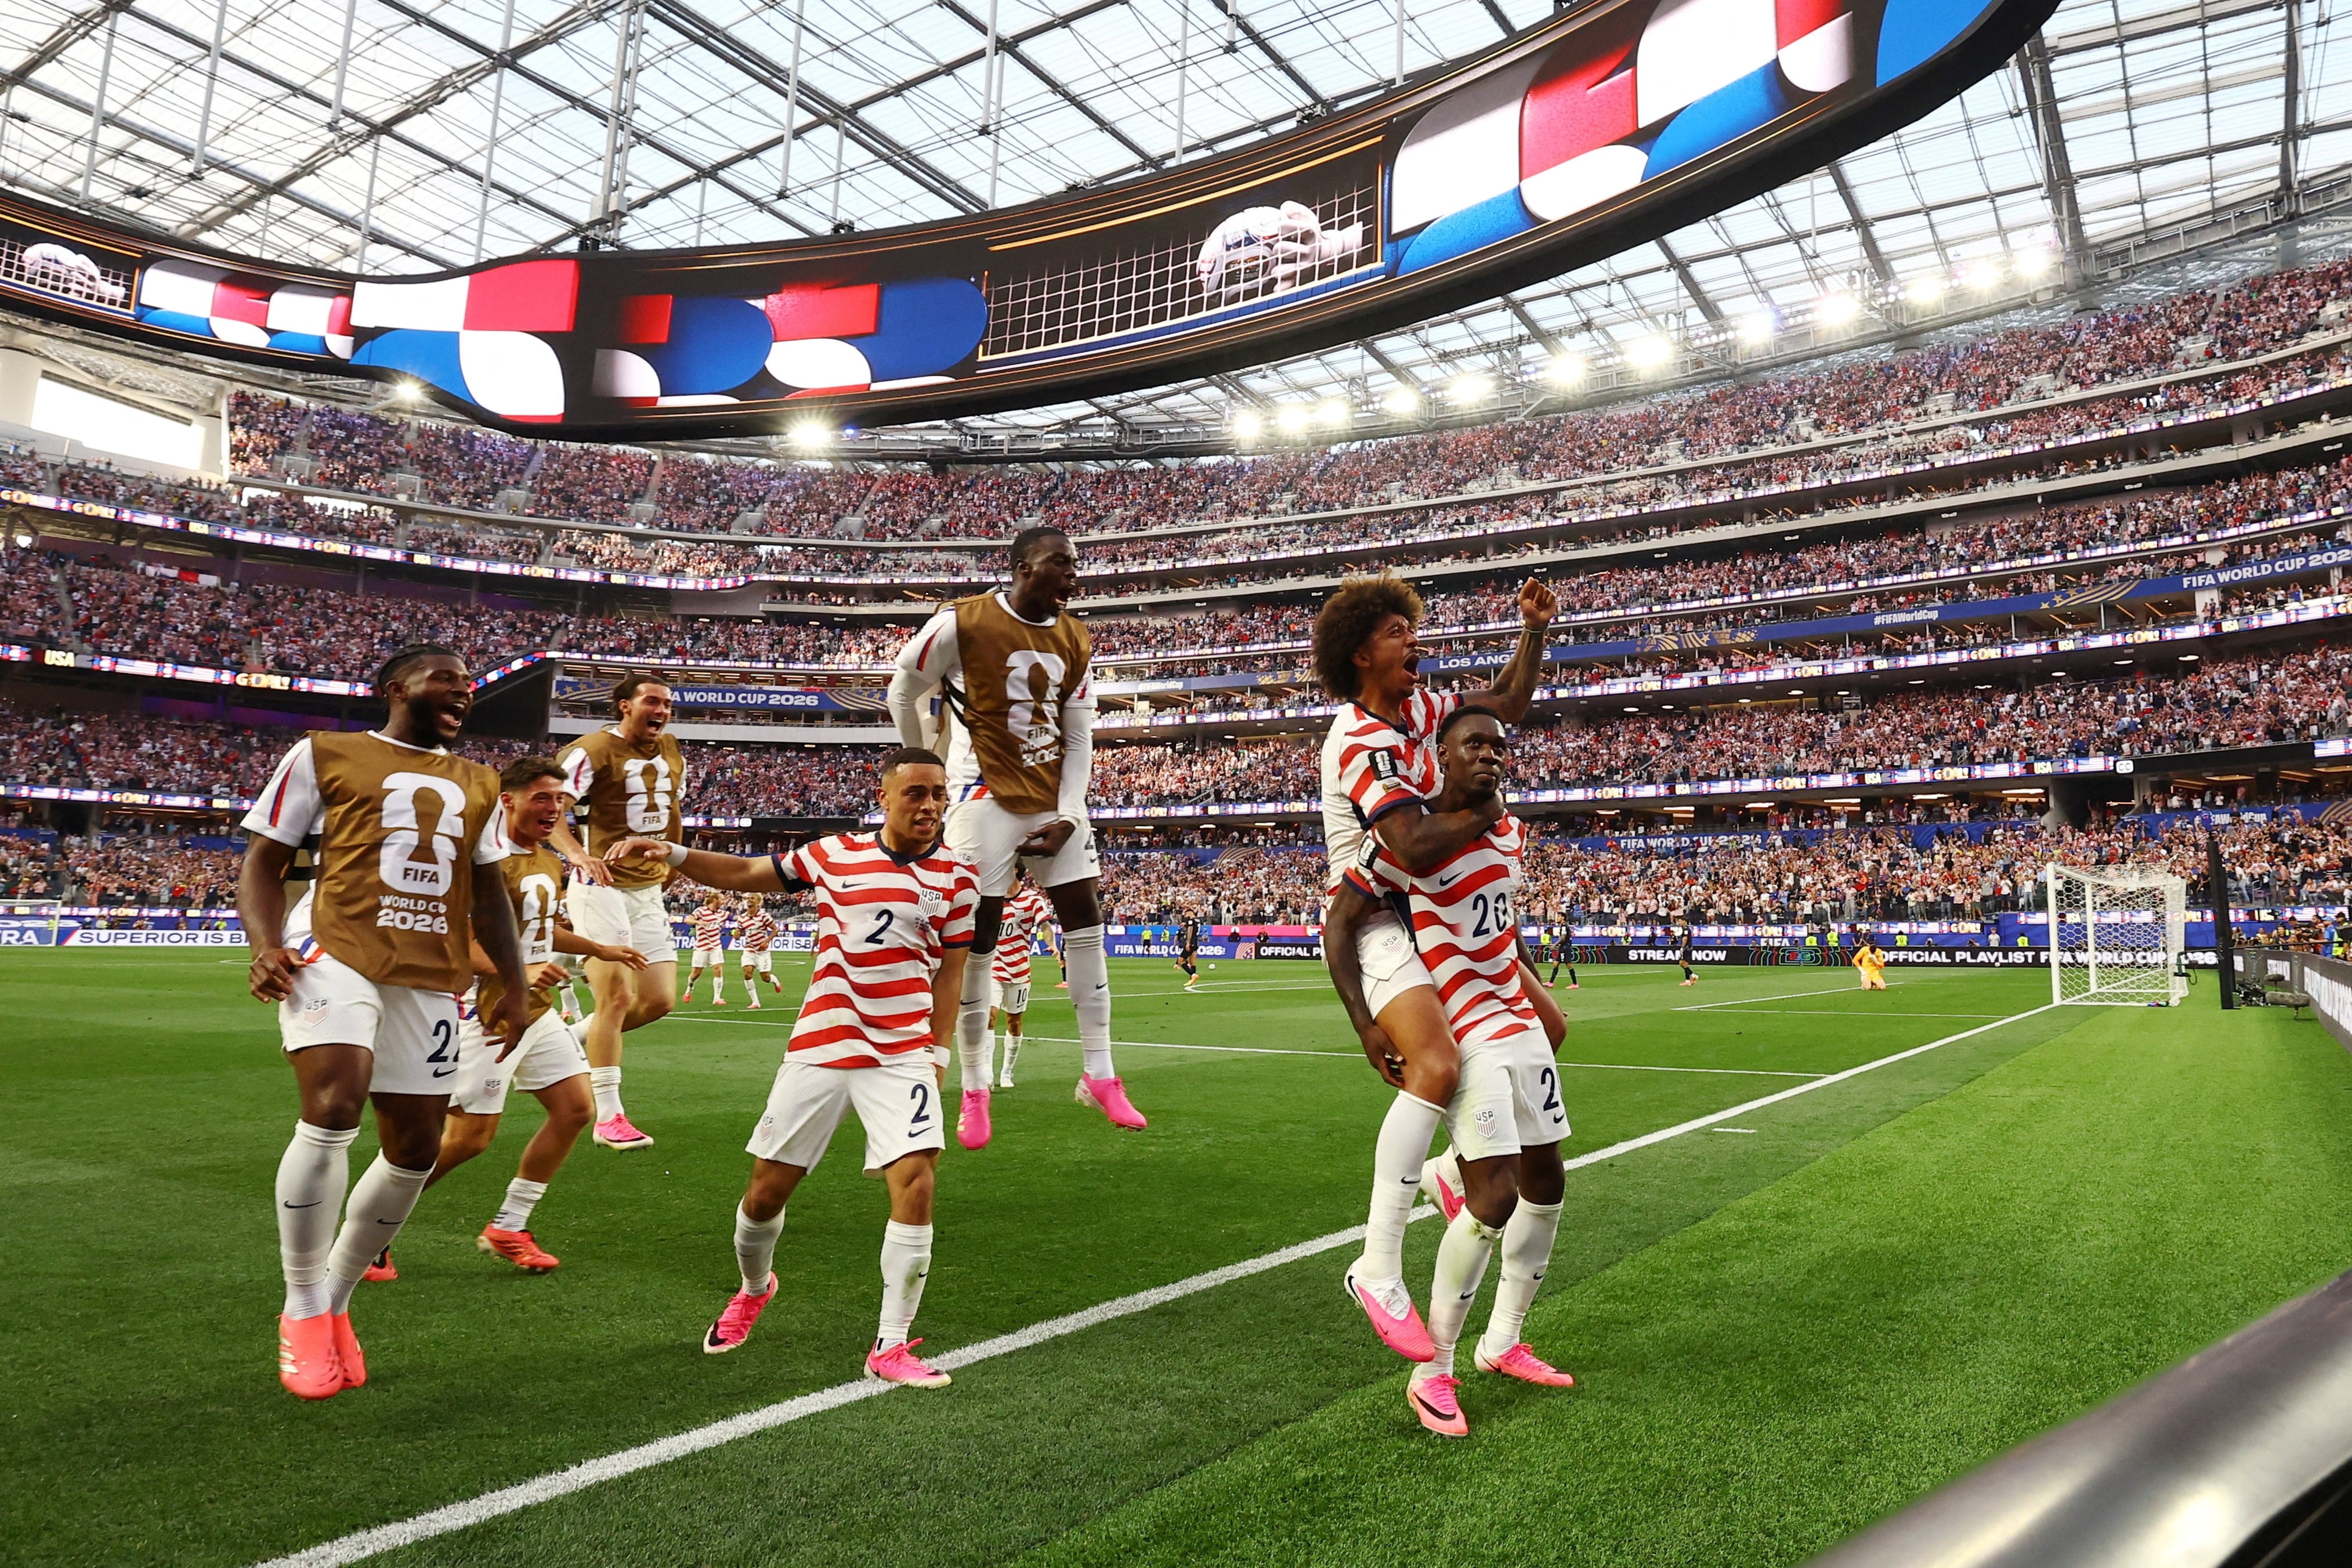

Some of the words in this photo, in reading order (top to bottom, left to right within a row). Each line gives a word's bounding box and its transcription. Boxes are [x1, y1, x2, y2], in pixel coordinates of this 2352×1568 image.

[2183, 574, 2216, 588] FIFA
[2217, 563, 2271, 582] WORLD
[2275, 556, 2307, 573] CUP
[1873, 610, 1939, 625] #FIFAWorldCup
[2221, 621, 2238, 632] USA
[44, 650, 75, 667] USA
[1439, 657, 1471, 669] LOS
[1474, 650, 1552, 666] ANGS
[236, 672, 291, 690] GOAL!
[683, 691, 736, 703] WORLD
[738, 693, 766, 704] CUP
[769, 694, 819, 706] 2026
[2034, 762, 2052, 774] USA
[2119, 763, 2130, 771] CC
[1865, 773, 1882, 784] USA
[643, 816, 660, 824] FIFA
[1620, 839, 1645, 849] FIFA
[403, 868, 439, 883] FIFA
[922, 889, 940, 901] USA
[379, 895, 427, 910] WORLD
[376, 908, 448, 935] 2026
[864, 909, 894, 944] 2
[997, 922, 1014, 937] 10
[79, 932, 198, 943] SUPERIOR
[205, 933, 224, 943] IS
[1381, 935, 1398, 947] USA
[1115, 944, 1134, 955] FIFA
[1260, 947, 1311, 957] OFFICIAL
[1692, 951, 1727, 961] NOW
[1883, 951, 1952, 963] OFFICIAL
[1956, 952, 2035, 963] PLAYLIST
[2136, 952, 2166, 964] CUP
[1016, 988, 1027, 1004] 10
[307, 1000, 327, 1011] USA
[426, 1019, 458, 1063] 2
[1541, 1067, 1559, 1111] 2
[910, 1084, 929, 1124] 2
[1475, 1110, 1493, 1122] USA
